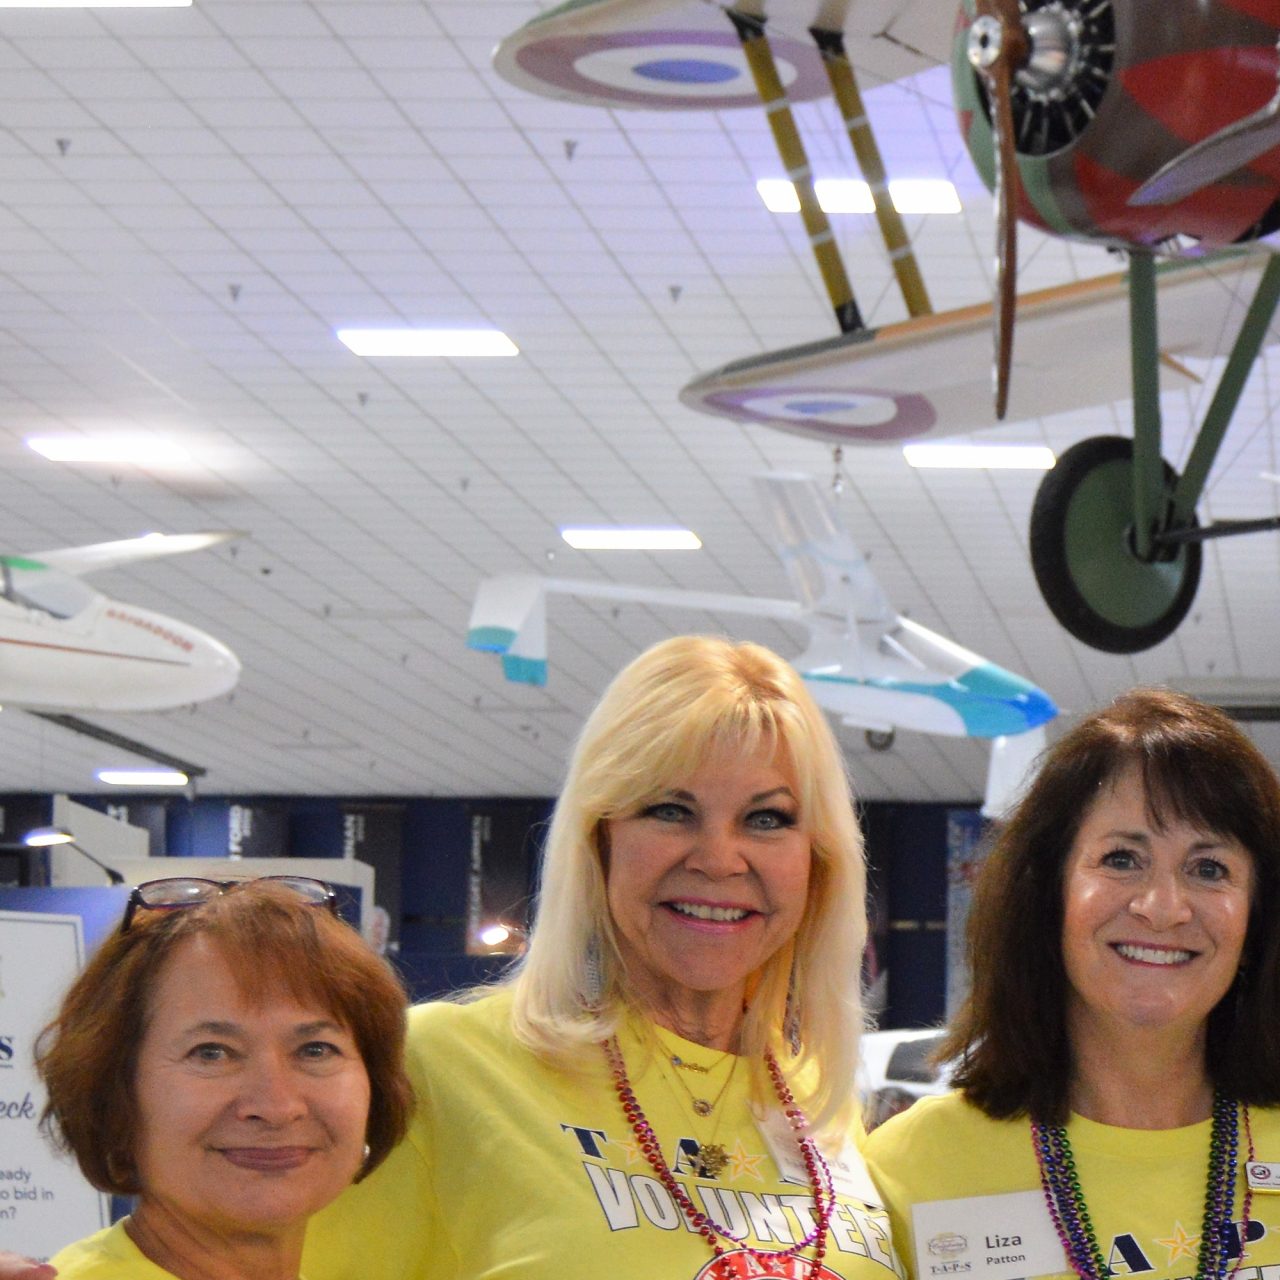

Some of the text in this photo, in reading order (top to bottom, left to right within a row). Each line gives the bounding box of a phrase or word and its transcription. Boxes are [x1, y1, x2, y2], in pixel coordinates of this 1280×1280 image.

[14, 1185, 37, 1200] bid
[41, 1187, 54, 1200] in
[986, 1234, 1022, 1249] Liza
[986, 1253, 1026, 1266] Patton
